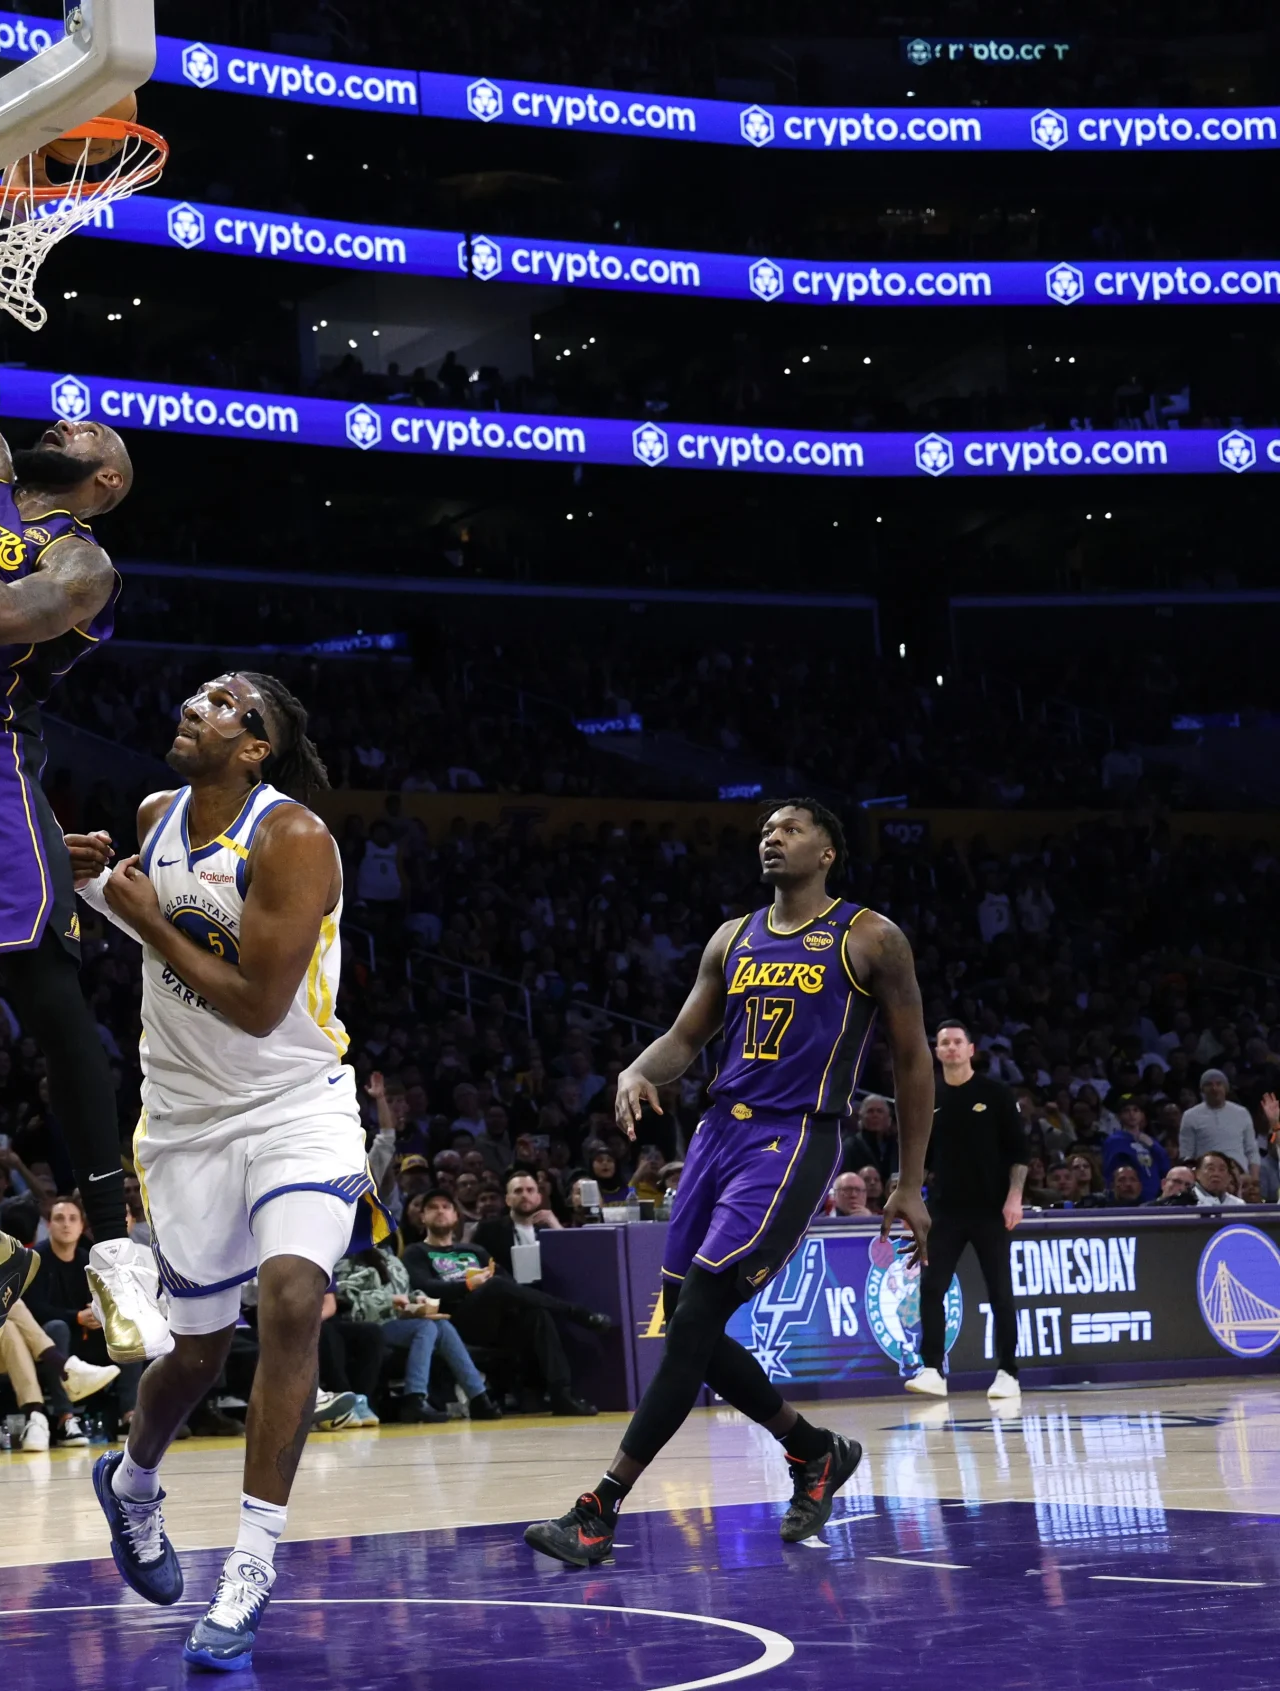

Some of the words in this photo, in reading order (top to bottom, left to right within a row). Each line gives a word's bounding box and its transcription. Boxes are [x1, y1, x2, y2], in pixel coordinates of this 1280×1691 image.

[227, 58, 417, 105] crypto.com
[512, 92, 696, 132] crypto.com
[784, 113, 981, 146] crypto.com
[1078, 113, 1277, 147] crypto.com
[214, 218, 406, 264] crypto.com
[511, 249, 700, 286] crypto.com
[792, 268, 992, 301] crypto.com
[100, 390, 298, 434] crypto.com
[391, 416, 586, 453] crypto.com
[677, 433, 864, 467] crypto.com
[964, 437, 1168, 471] crypto.com
[199, 871, 235, 884] Rakuten
[201, 899, 238, 930] STATE
[208, 932, 225, 957] 5
[805, 935, 832, 946] bibigo
[727, 956, 826, 994] LAKERS
[742, 996, 795, 1060] 17
[1009, 1236, 1137, 1297] EDNESDAY
[824, 1286, 859, 1338] VS
[868, 1269, 893, 1347] BOSTON
[979, 1303, 994, 1359] 7
[1035, 1306, 1063, 1357] ET
[1071, 1310, 1152, 1344] ESPN
